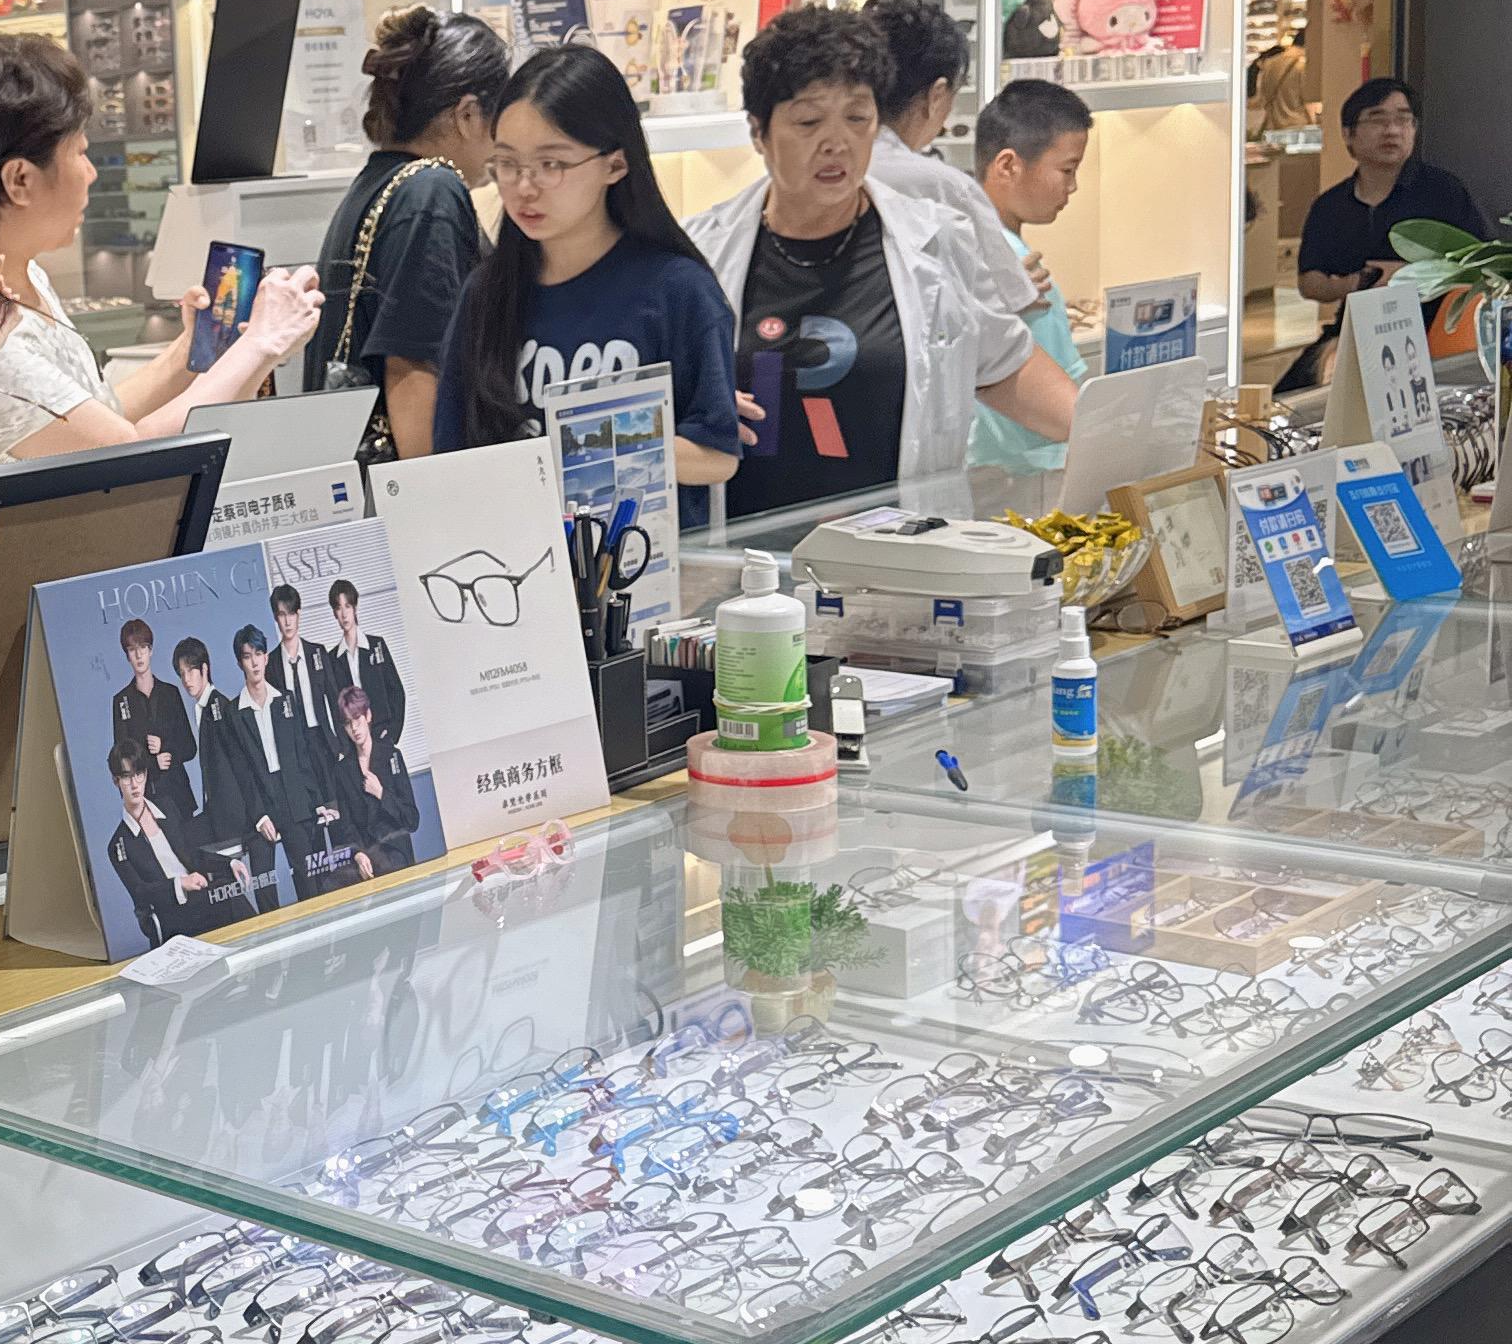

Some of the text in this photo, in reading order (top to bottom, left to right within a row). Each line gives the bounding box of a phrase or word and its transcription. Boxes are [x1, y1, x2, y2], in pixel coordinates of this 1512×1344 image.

[97, 565, 219, 624] HORIEN
[476, 753, 563, 794] 经典商务方框
